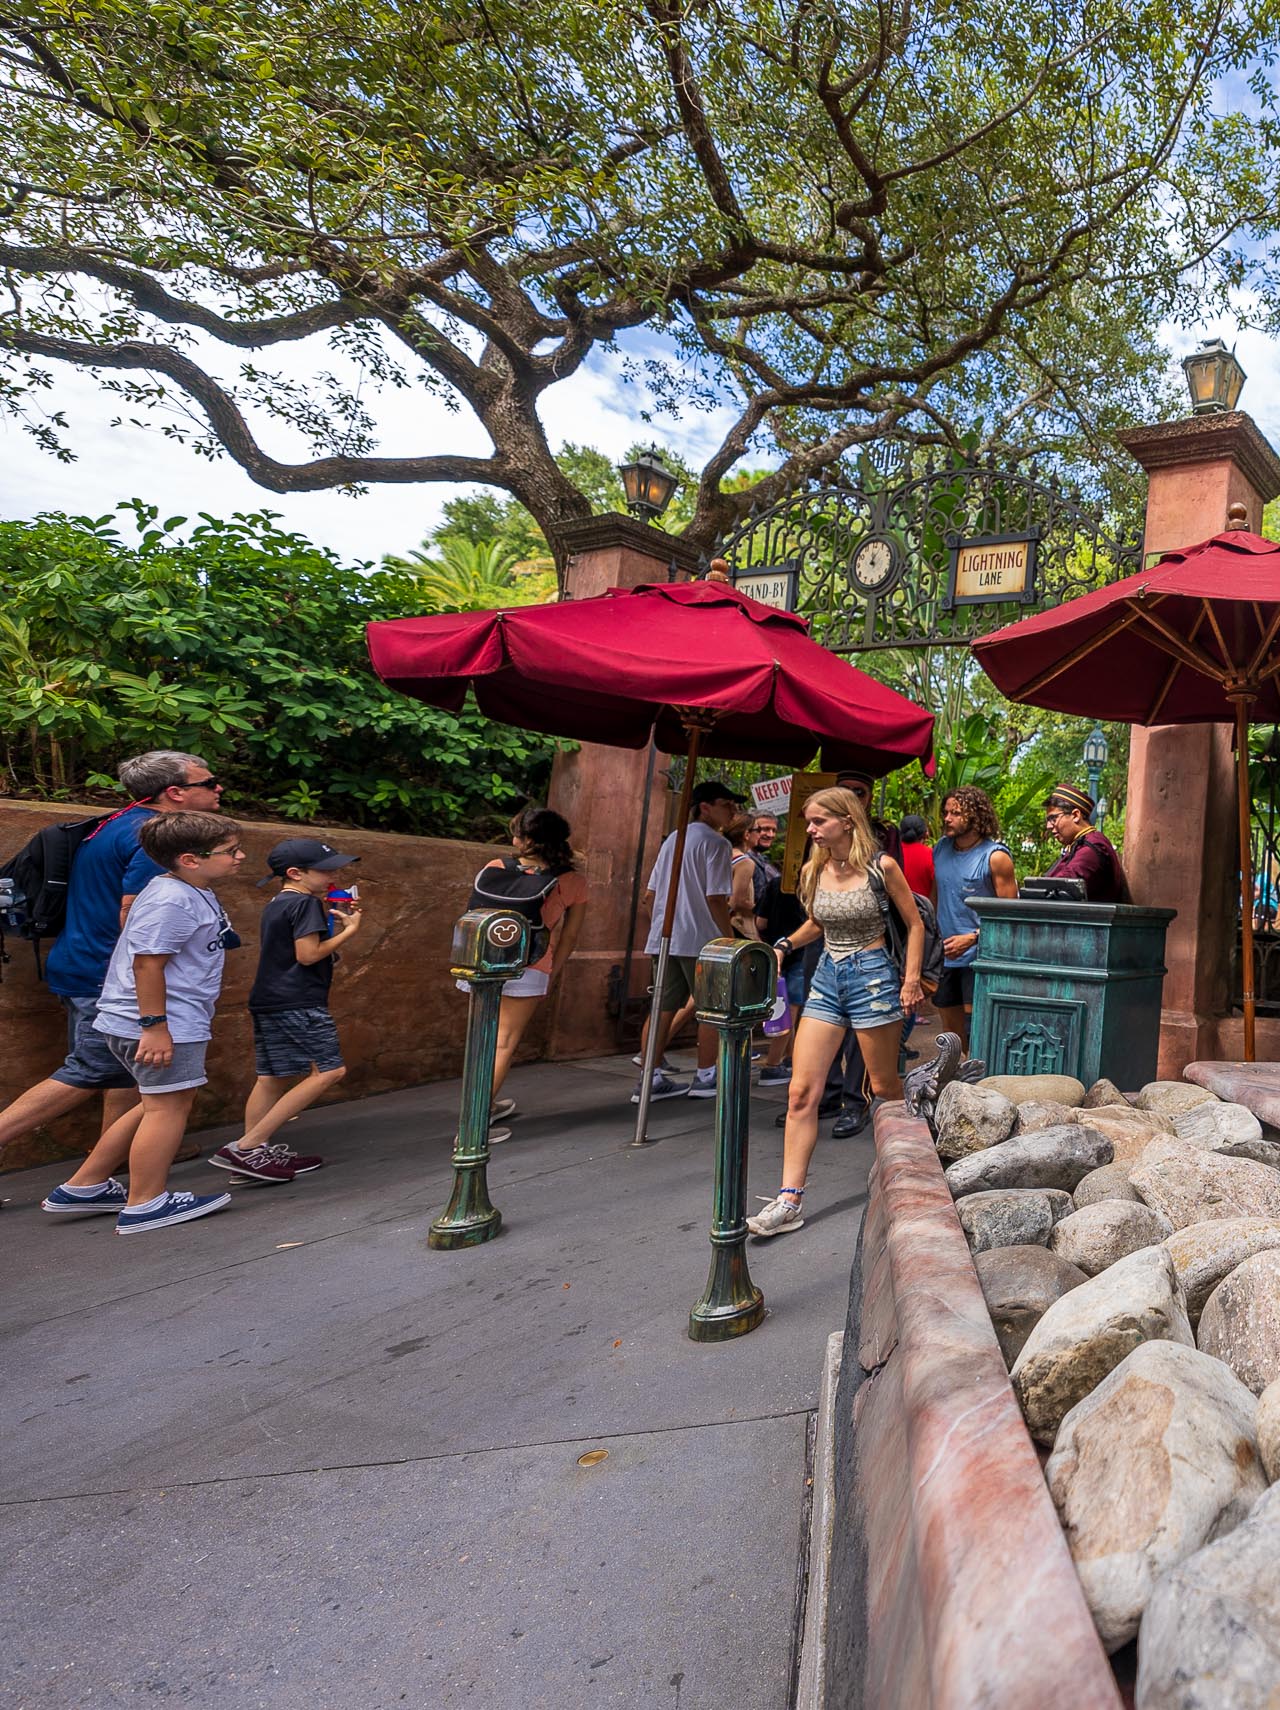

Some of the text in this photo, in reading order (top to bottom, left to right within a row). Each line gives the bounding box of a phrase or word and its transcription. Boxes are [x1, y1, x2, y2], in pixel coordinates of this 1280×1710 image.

[962, 551, 1023, 572] LIGHTNING
[979, 571, 1003, 586] LANE
[755, 782, 779, 802] KEEP
